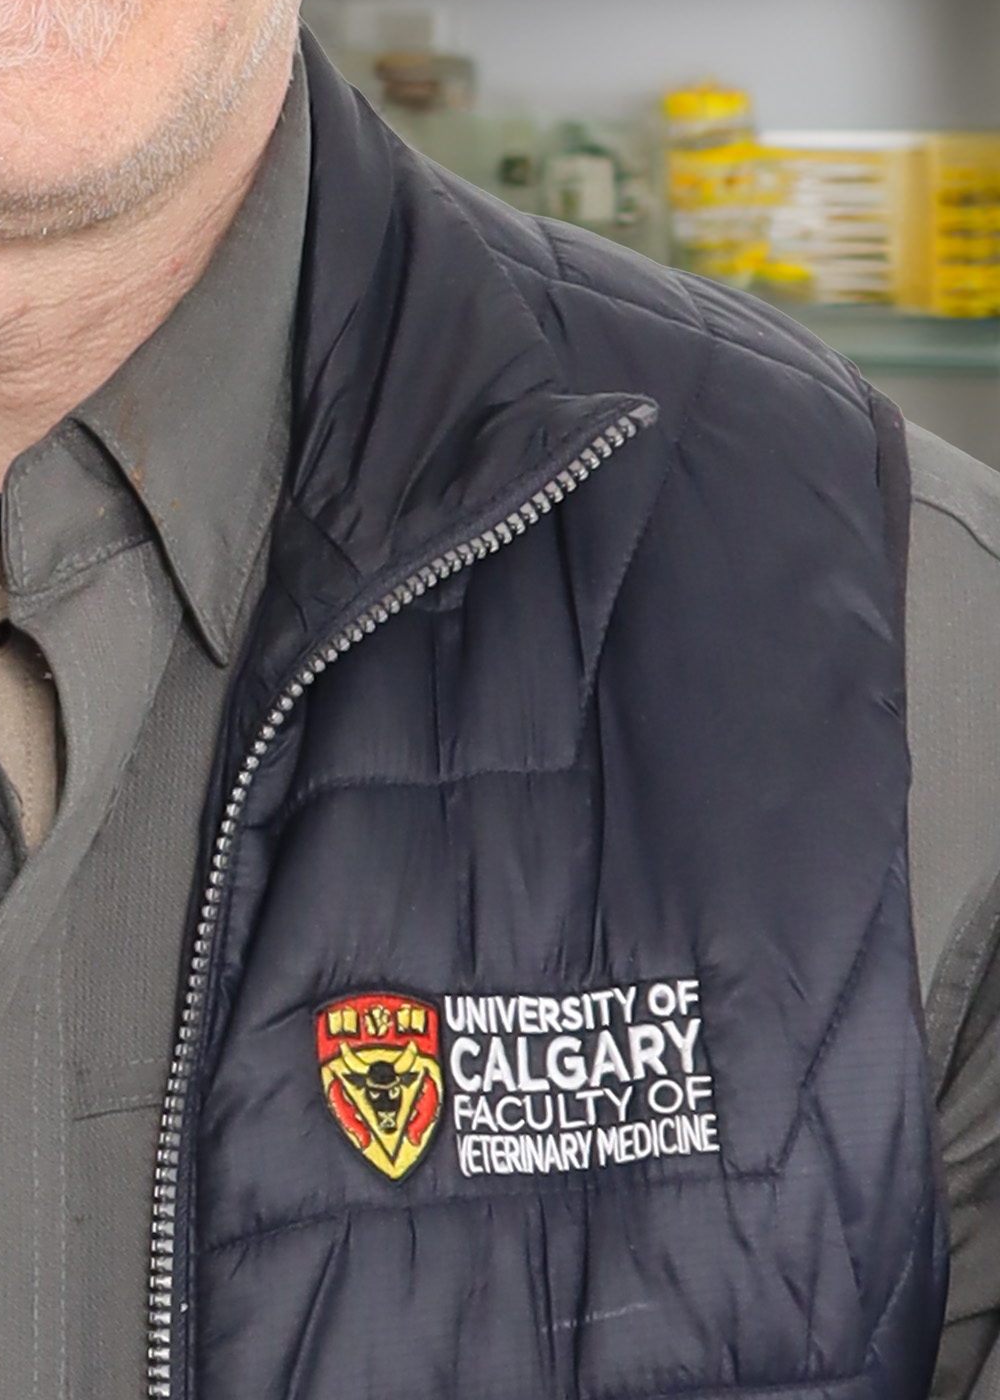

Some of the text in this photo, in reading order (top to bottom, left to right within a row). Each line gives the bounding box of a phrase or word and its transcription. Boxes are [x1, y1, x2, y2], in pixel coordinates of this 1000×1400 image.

[445, 979, 700, 1034] UNIVERSITY OF
[450, 1018, 702, 1092] CALGARY
[453, 1075, 713, 1131] FACULTY OF
[456, 1113, 720, 1177] VETERINARY MEDICINE
